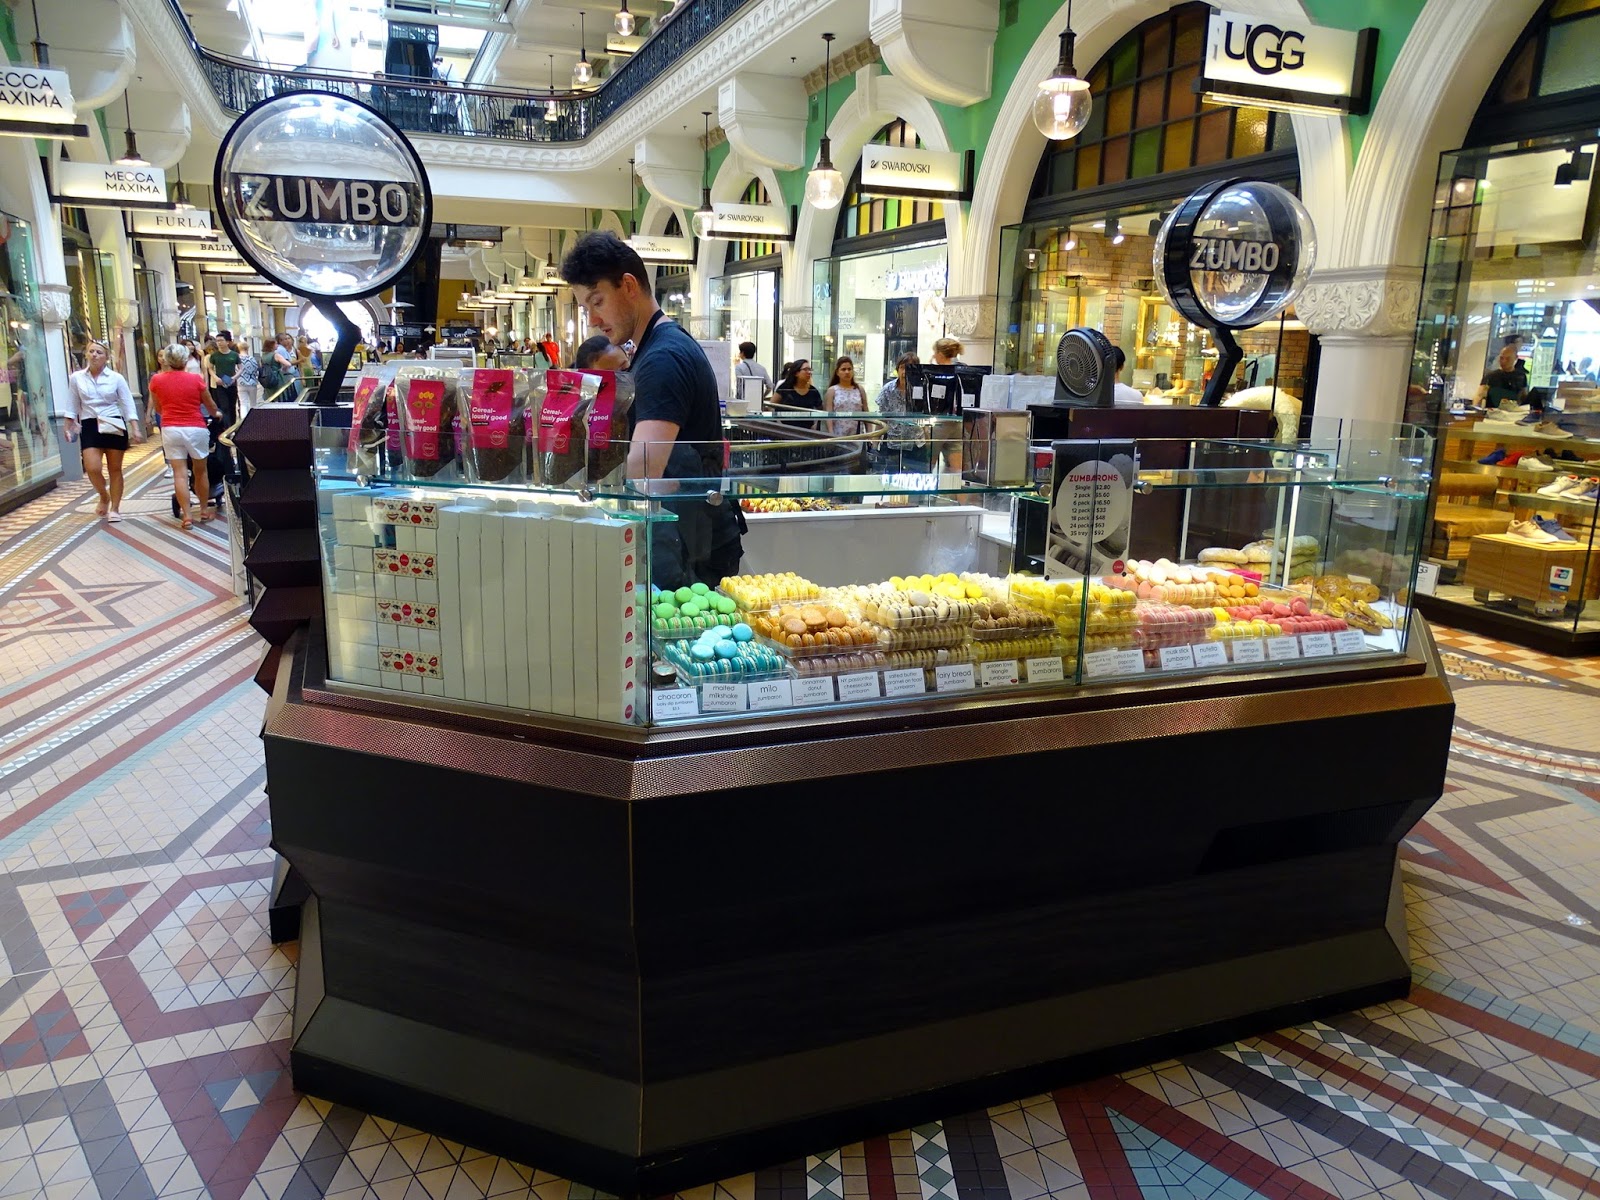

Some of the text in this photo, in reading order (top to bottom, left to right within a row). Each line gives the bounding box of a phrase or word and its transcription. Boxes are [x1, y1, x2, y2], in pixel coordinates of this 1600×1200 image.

[1224, 20, 1306, 76] UGG
[0, 71, 53, 91] ECCA
[0, 90, 63, 109] AXIMA
[881, 160, 931, 174] SWAROVSKI
[105, 171, 155, 183] MECCA
[106, 182, 160, 195] MAXIMA
[242, 175, 409, 224] ZUMBO
[156, 215, 207, 229] FURLA
[727, 213, 764, 223] SWAROVSKI
[201, 243, 233, 252] BALLY
[1190, 238, 1280, 272] ZUMBO
[1069, 474, 1119, 482] ZUMBARONS
[951, 669, 972, 677] bread
[760, 684, 778, 693] milo
